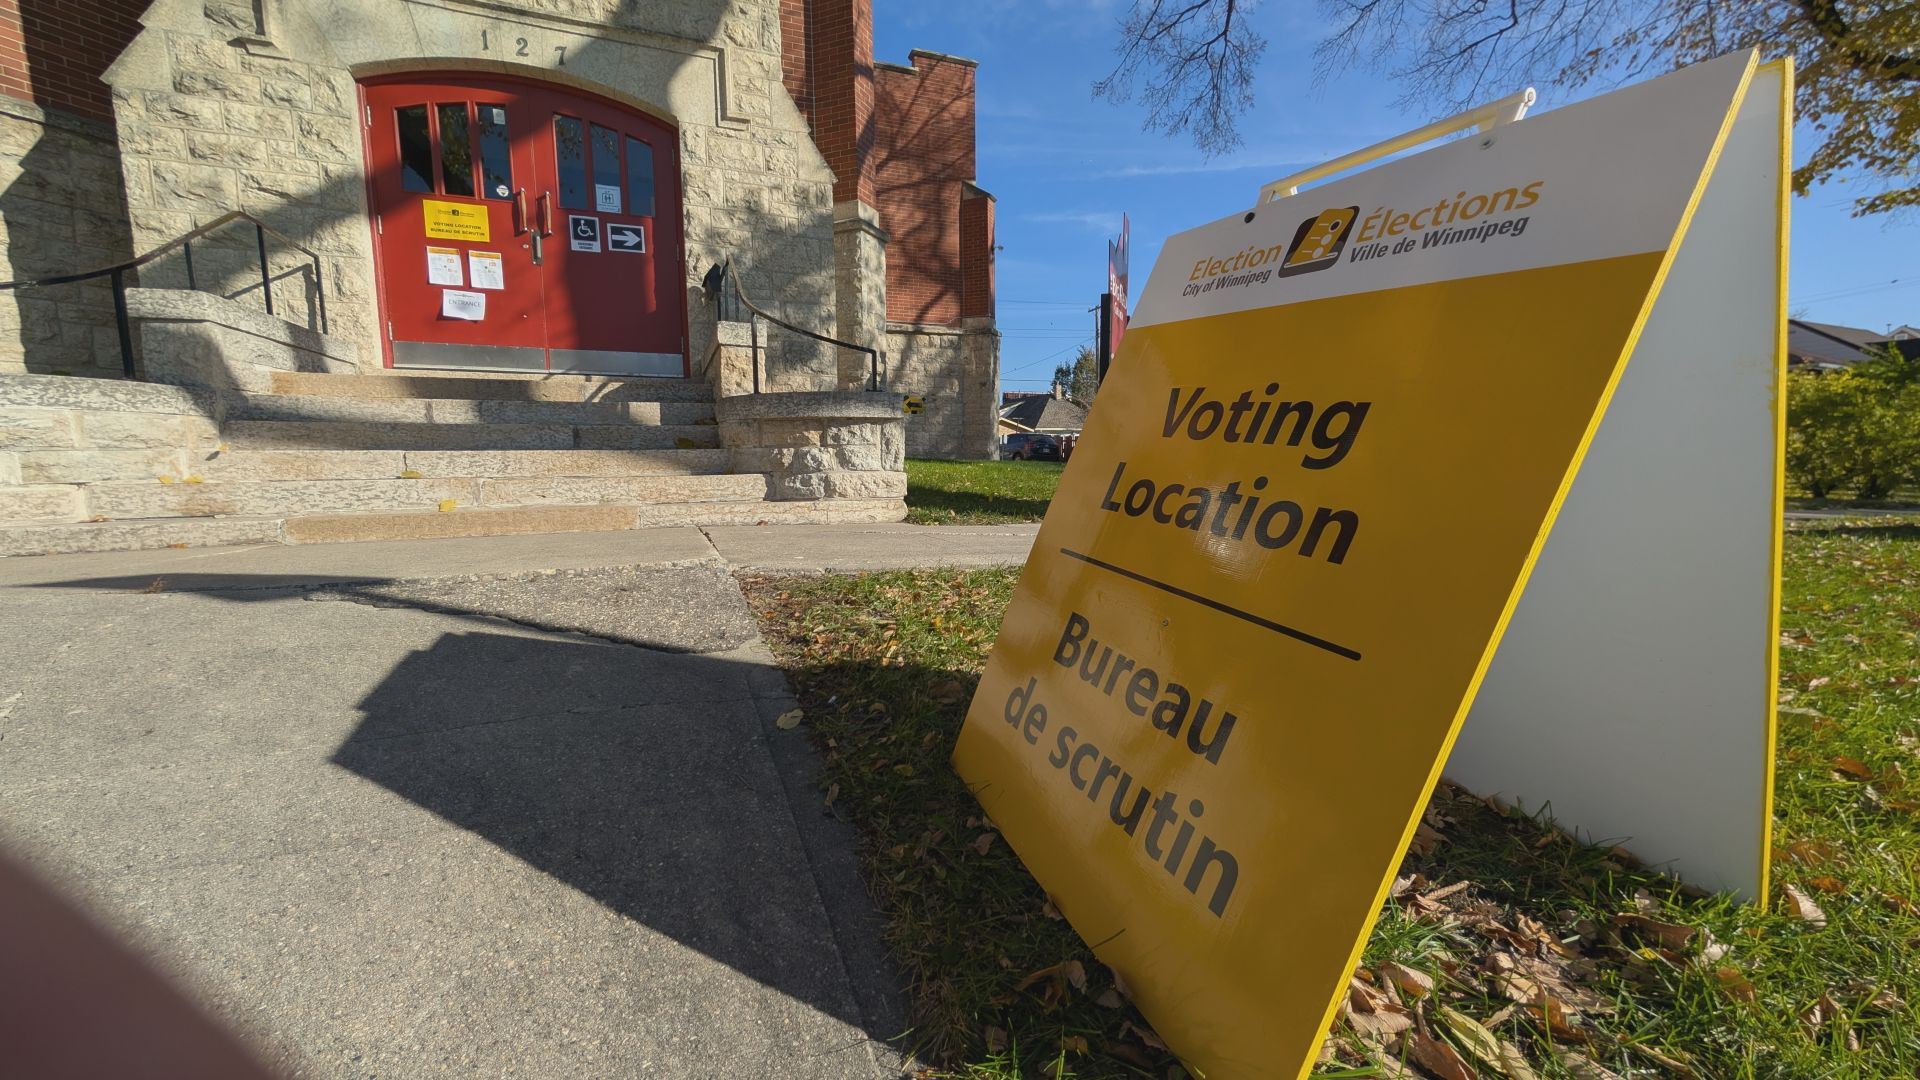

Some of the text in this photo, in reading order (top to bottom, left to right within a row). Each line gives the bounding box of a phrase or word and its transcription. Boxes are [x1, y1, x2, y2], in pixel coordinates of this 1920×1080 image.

[481, 30, 567, 65] 127
[1356, 180, 1544, 243] Élections
[1189, 244, 1282, 281] Election
[1350, 216, 1530, 263] Ville de Winnipeg
[448, 299, 481, 308] ENTRANCE
[1182, 269, 1272, 297] City of Winnipeg
[1162, 383, 1371, 470] Voting
[1100, 461, 1359, 565] Location
[1053, 612, 1238, 765] Bureau
[1003, 677, 1239, 918] de scrutin
